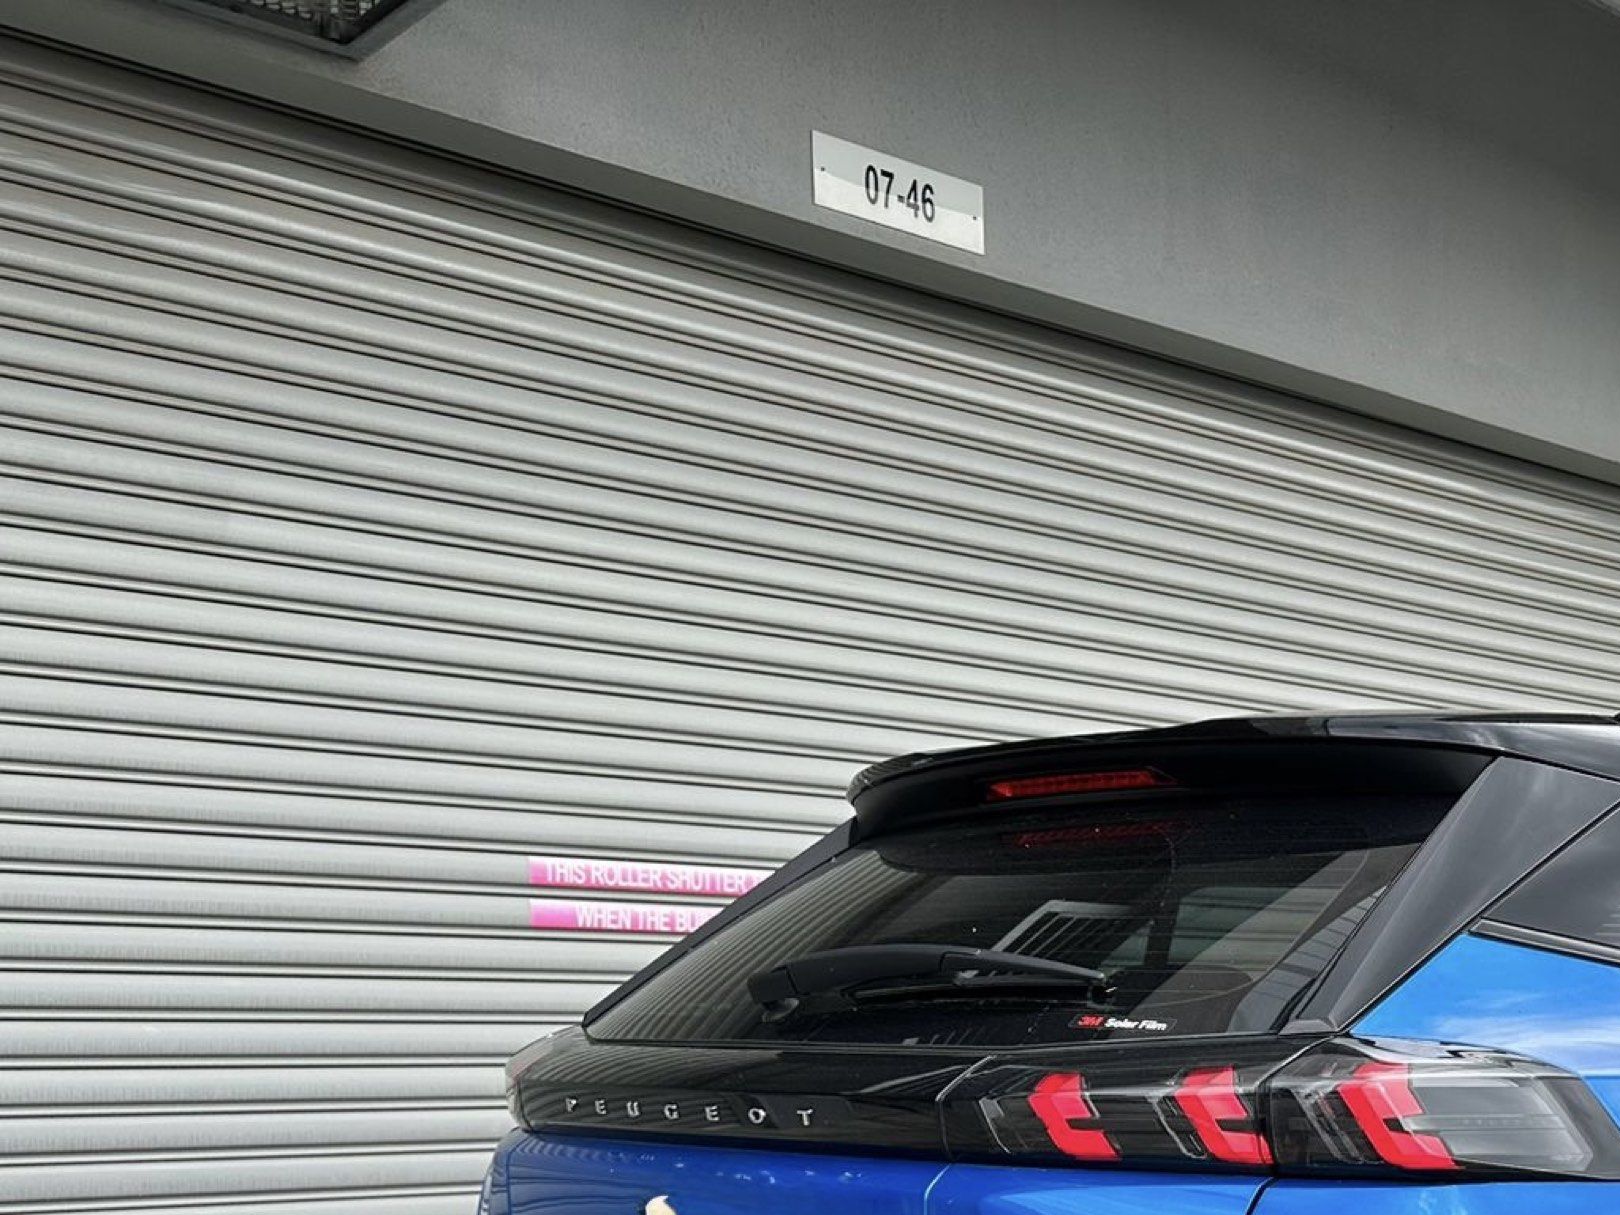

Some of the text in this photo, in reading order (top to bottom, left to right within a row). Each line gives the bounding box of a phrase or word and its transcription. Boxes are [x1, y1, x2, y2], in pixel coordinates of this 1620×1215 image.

[863, 164, 936, 222] 07-46
[546, 861, 586, 884] THIS
[591, 863, 661, 888] ROLLER
[665, 867, 745, 893] SHUTTER
[576, 904, 631, 930] WHEN
[636, 907, 672, 931] THE
[565, 1098, 814, 1127] PEUGEOT
